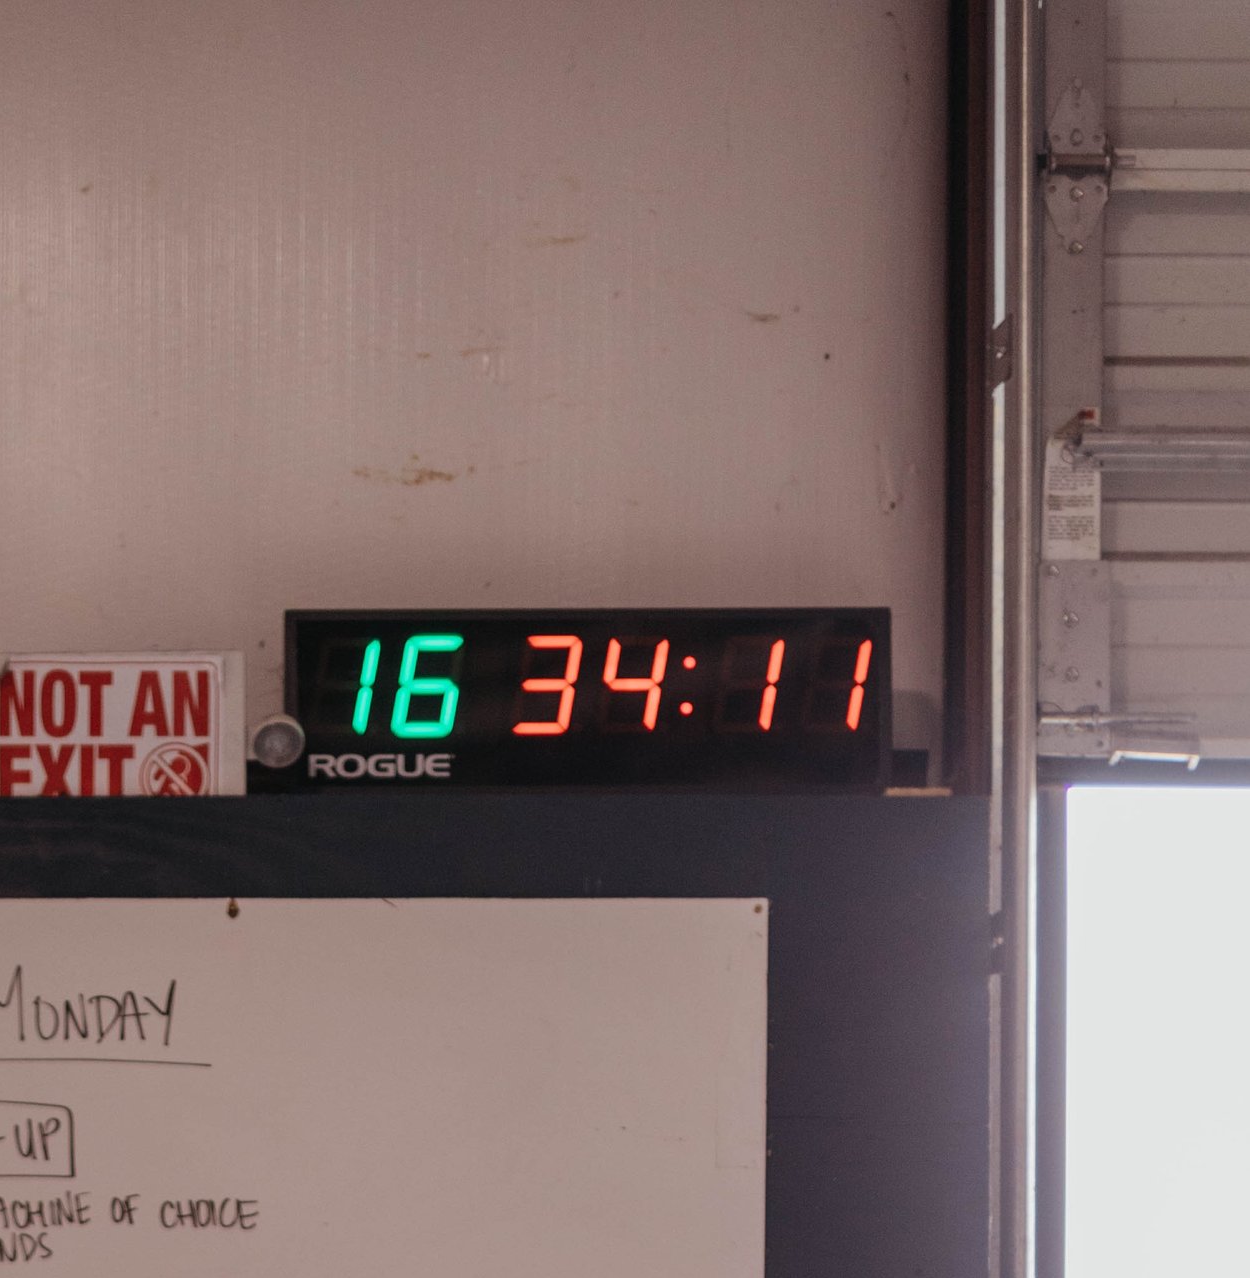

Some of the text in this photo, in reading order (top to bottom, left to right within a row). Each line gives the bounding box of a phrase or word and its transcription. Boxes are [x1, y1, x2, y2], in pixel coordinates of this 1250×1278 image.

[128, 670, 210, 738] AN
[351, 634, 465, 740] 16
[307, 752, 453, 778] ROGUE
[110, 1193, 141, 1225] OF
[159, 1196, 261, 1231] CHOICE
